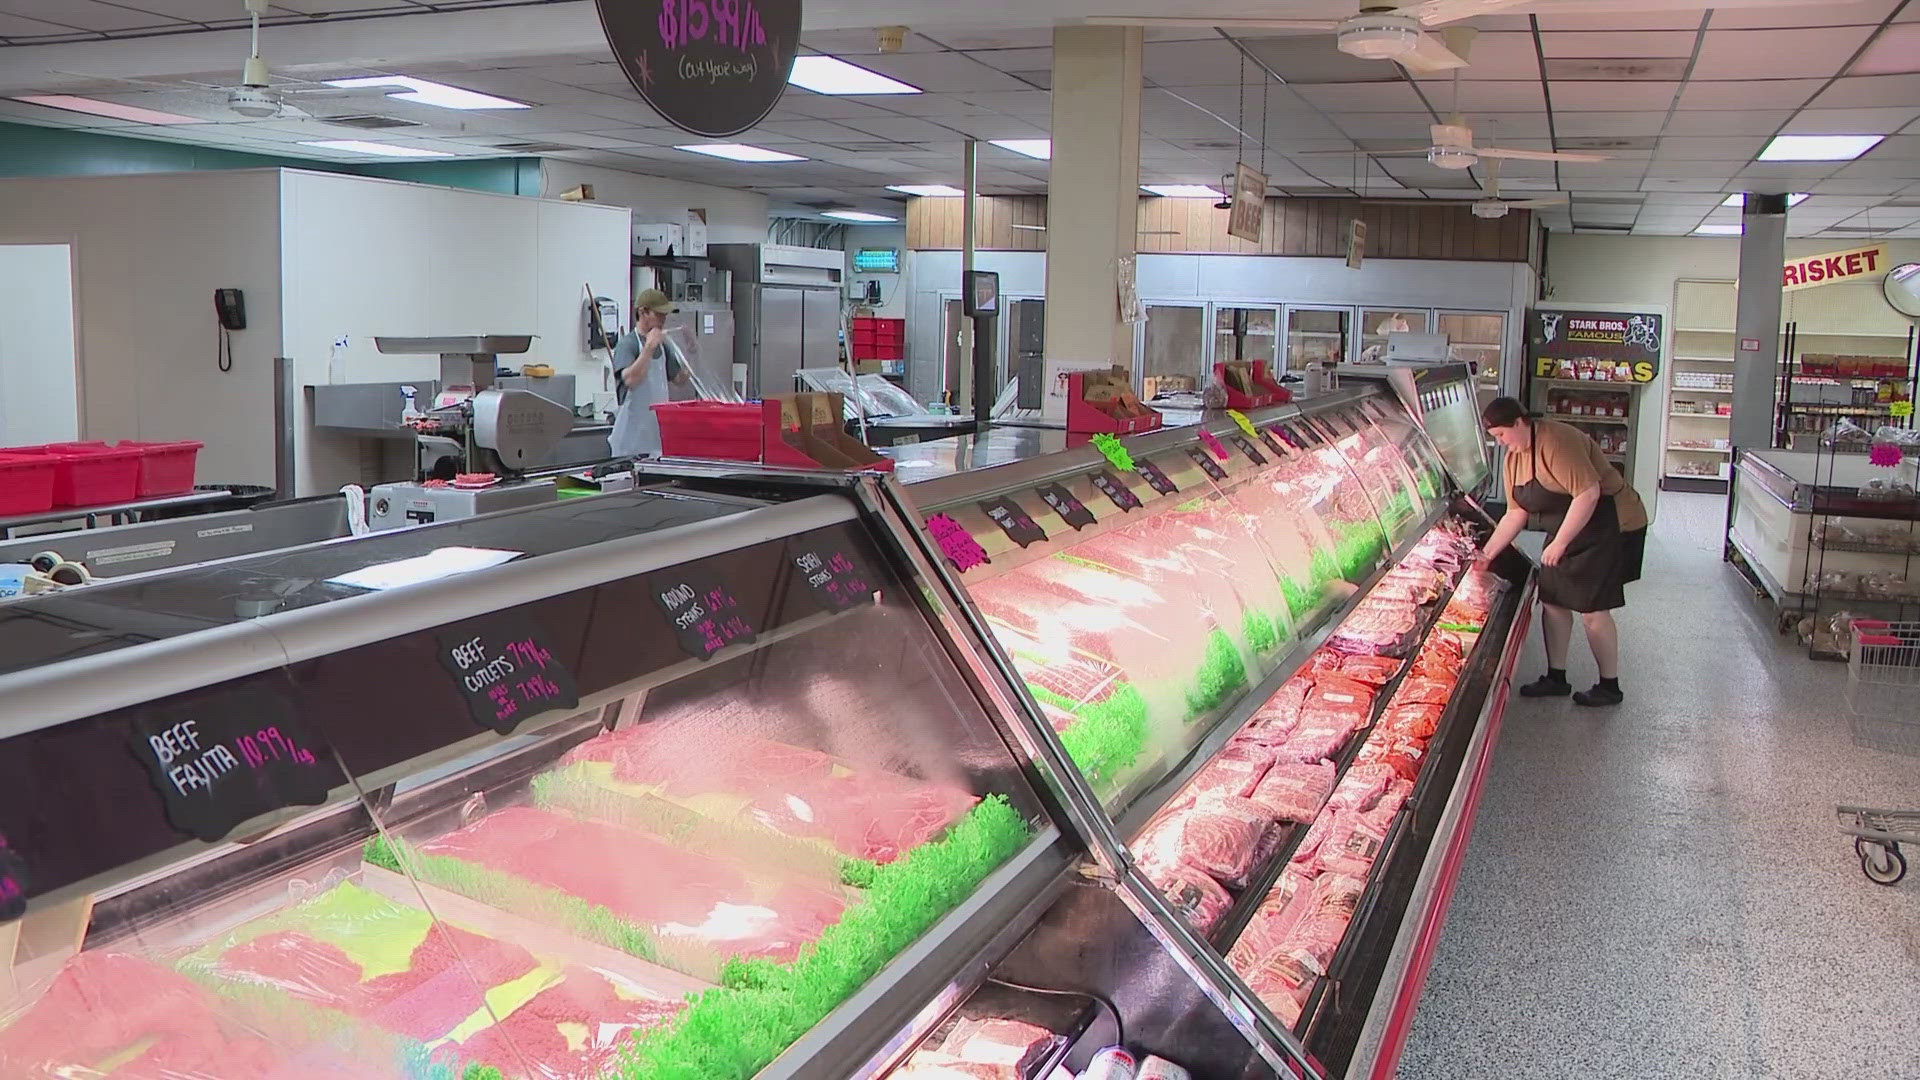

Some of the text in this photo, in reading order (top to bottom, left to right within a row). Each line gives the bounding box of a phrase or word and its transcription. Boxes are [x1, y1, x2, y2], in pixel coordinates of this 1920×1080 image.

[1783, 249, 1879, 286] RISKET
[1568, 331, 1623, 340] FAMOUS
[1569, 320, 1626, 331] STARK BROS.
[661, 584, 695, 612] ROUND
[675, 602, 705, 630] STEAKS
[451, 636, 486, 670] BEEF
[464, 656, 515, 693] CUTLETS
[149, 719, 201, 764] BEEF
[168, 744, 239, 797] FAJITA
